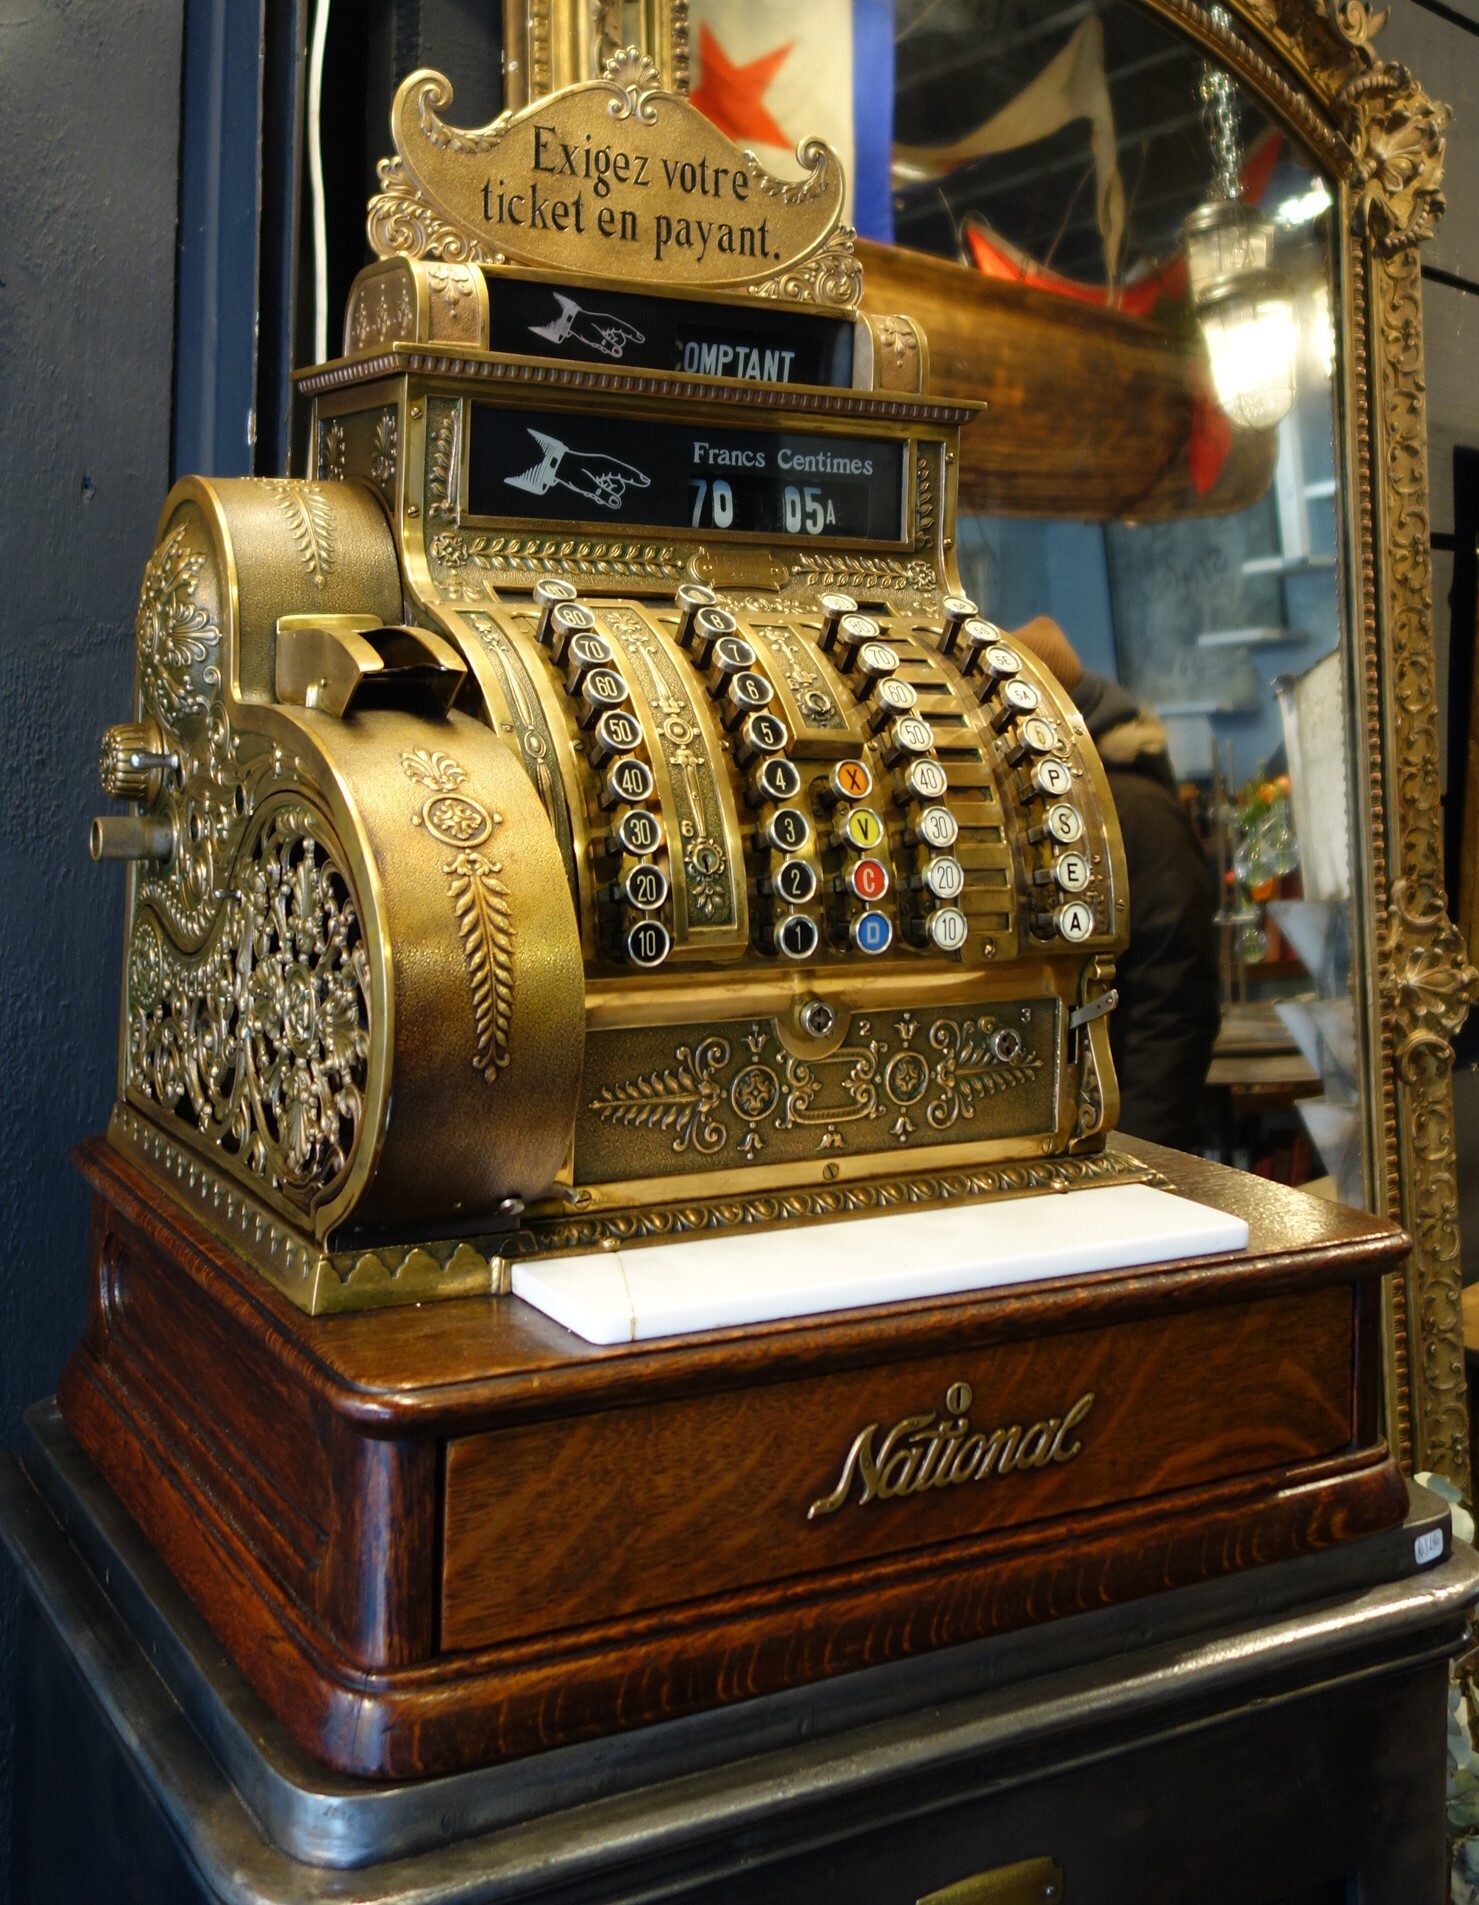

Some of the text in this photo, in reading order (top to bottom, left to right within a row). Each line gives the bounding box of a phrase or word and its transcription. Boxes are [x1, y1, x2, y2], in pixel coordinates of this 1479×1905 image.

[533, 125, 750, 201] Exigez votre
[481, 177, 782, 263] ticket en payant.
[693, 441, 873, 475] Francs Centimes
[688, 478, 734, 529] 70
[562, 609, 587, 626] 80
[710, 614, 725, 629] 8
[848, 619, 871, 633] 80
[579, 640, 605, 659] 70
[727, 644, 741, 662] 7
[868, 649, 891, 666] 70
[994, 655, 1012, 667] 5E
[595, 676, 618, 697] 60
[745, 679, 759, 700] 6
[887, 685, 908, 704] 60
[1014, 690, 1032, 702] 5A
[608, 719, 633, 742] 50
[760, 722, 774, 744] 5
[904, 724, 926, 745] 50
[622, 768, 643, 794] 40
[775, 767, 787, 792] 4
[846, 769, 862, 791] X
[919, 767, 938, 790] 40
[1047, 769, 1060, 787] P
[629, 818, 652, 846] 30
[680, 819, 695, 838] 6
[783, 817, 797, 844] 3
[856, 817, 870, 841] V
[930, 815, 949, 840] 30
[1058, 812, 1072, 835] S
[790, 868, 802, 895] 2
[861, 867, 876, 894] C
[937, 865, 955, 890] 20
[1066, 862, 1080, 882] E
[636, 874, 657, 902] 20
[865, 920, 881, 945] D
[941, 917, 957, 942] 10
[1069, 911, 1083, 932] A
[638, 929, 656, 957] 10
[795, 924, 803, 951] 1
[806, 1391, 1097, 1520] National
